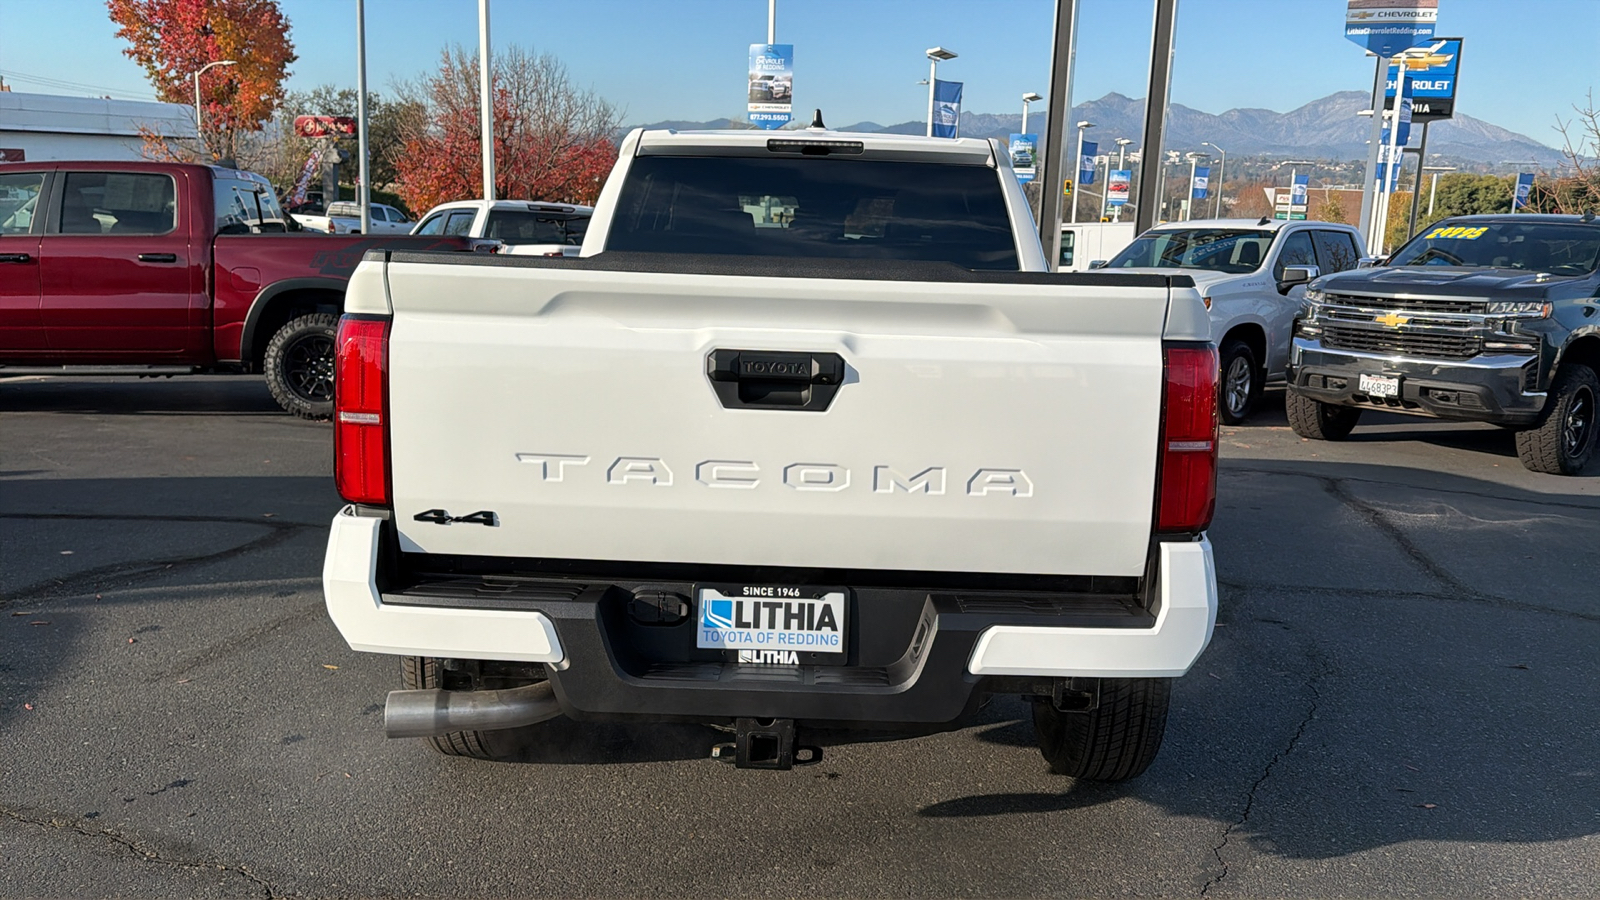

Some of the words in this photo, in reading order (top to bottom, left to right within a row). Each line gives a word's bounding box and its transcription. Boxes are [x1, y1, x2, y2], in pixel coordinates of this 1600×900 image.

[1347, 26, 1432, 36] LithiaChevroletRedding.com
[1425, 227, 1489, 239] 24995
[744, 361, 809, 375] TOYOTA
[516, 452, 1034, 497] TACOMA
[743, 586, 774, 597] SINCE
[777, 587, 800, 597] 1946
[735, 601, 839, 632] LITHIA
[703, 630, 752, 643] TOYOTA
[757, 631, 774, 644] OF
[778, 633, 839, 646] REDDING
[753, 650, 800, 665] LITHIA
